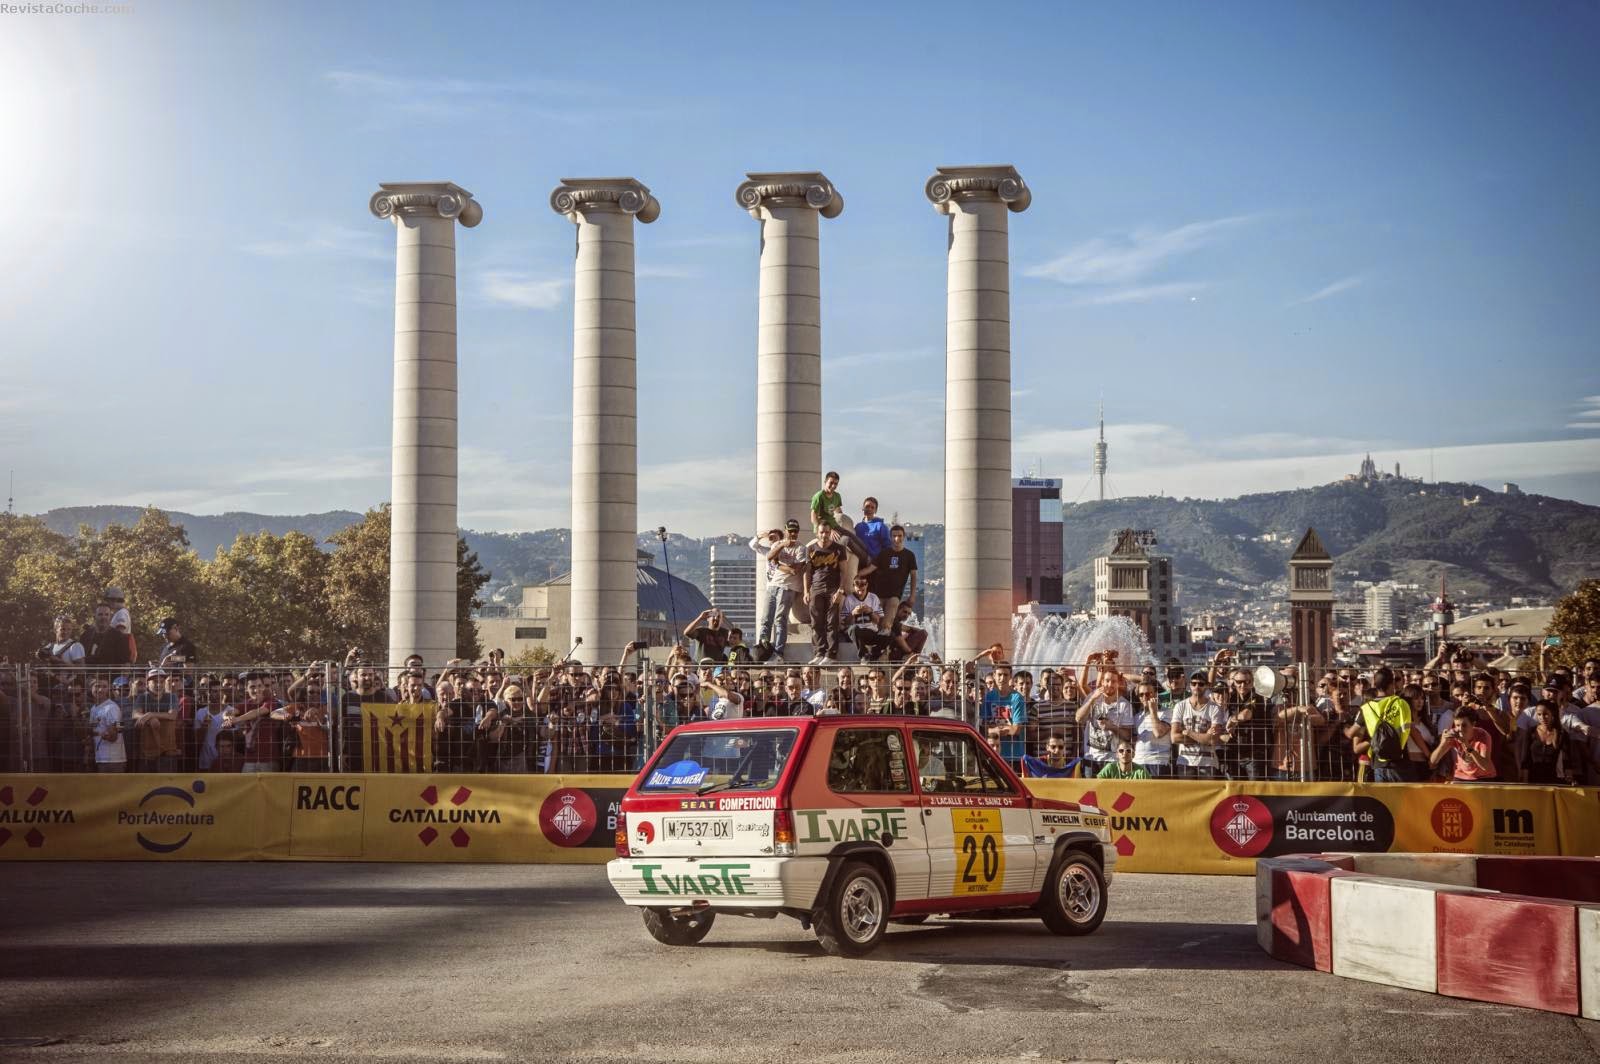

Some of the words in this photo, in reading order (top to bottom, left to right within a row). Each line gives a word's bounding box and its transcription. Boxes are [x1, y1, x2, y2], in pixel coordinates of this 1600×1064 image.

[649, 771, 672, 785] RALLYE
[298, 786, 360, 810] RACC
[681, 801, 716, 809] SEAT
[719, 796, 777, 811] COMPETICION
[118, 811, 214, 825] PortAventura
[389, 809, 500, 823] CATALUNYA
[1042, 814, 1080, 824] MICHELIN
[1286, 810, 1358, 823] Ajuntament
[1359, 811, 1374, 823] de
[797, 808, 908, 842] IVARTE
[1286, 825, 1374, 841] Barcelona
[963, 834, 998, 883] 20
[632, 864, 758, 896] IVARTE
